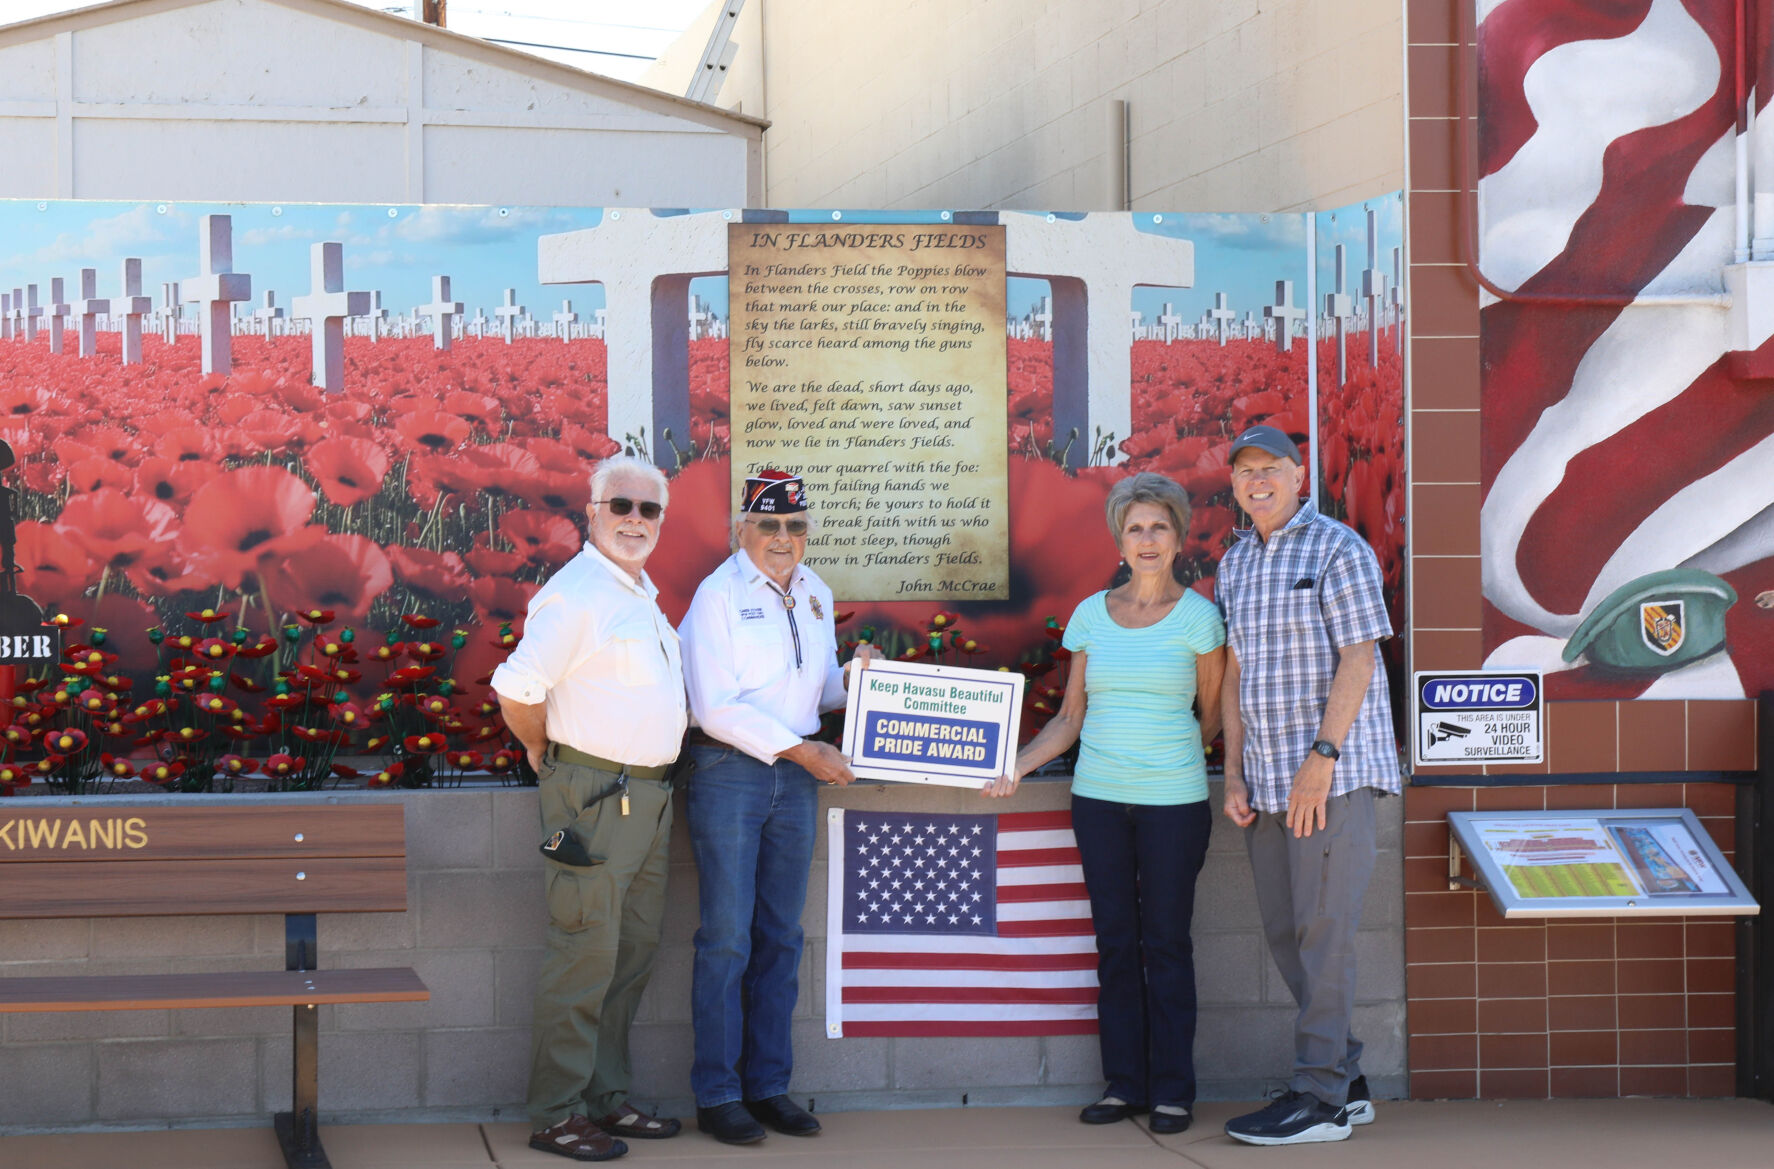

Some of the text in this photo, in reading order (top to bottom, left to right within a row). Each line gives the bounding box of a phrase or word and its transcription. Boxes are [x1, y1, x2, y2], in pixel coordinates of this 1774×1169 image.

[750, 233, 987, 251] IN FLANDERS FIELDS
[744, 264, 987, 280] In Flanders Field the Poppies blow
[745, 282, 968, 295] between the crosses, row on row
[745, 300, 966, 316] that mark our place: and in the
[745, 319, 985, 334] sky the larks, still bravely singing,
[742, 337, 972, 352] fly scarce heard among the guns
[745, 355, 789, 367] below.
[746, 381, 973, 396] We are the dead, short days ago,
[746, 399, 962, 415] we lived, felt dawn, saw sunset
[745, 417, 973, 433] glow, loved and were loved, and
[746, 435, 955, 450] now we lie in Flanders Fields.
[746, 461, 980, 476] Take up our quarrel with the foe:
[803, 480, 949, 495] rom failing hands we
[820, 498, 861, 511] torch;
[865, 498, 880, 509] be
[885, 501, 924, 513] yours
[929, 499, 942, 509] to
[946, 498, 976, 509] hold
[980, 498, 991, 509] it
[822, 516, 863, 528] break
[864, 516, 900, 531] faith
[904, 515, 937, 527] with
[941, 519, 956, 527] us
[960, 515, 989, 527] who
[806, 534, 951, 549] all not sleep, though
[804, 552, 982, 567] grow in Flanders Fields.
[896, 579, 996, 594] John McCrae
[870, 679, 1003, 703] Keep Havasu Beautiful
[1434, 684, 1522, 703] NOTICE
[904, 697, 967, 715] Committee
[876, 719, 987, 743] COMMERCIAL
[1485, 722, 1530, 734] 24 HOUR
[1492, 735, 1524, 745] VIDEO
[874, 737, 986, 761] PRIDE AWARD
[1464, 746, 1531, 756] SURVEILLANCE
